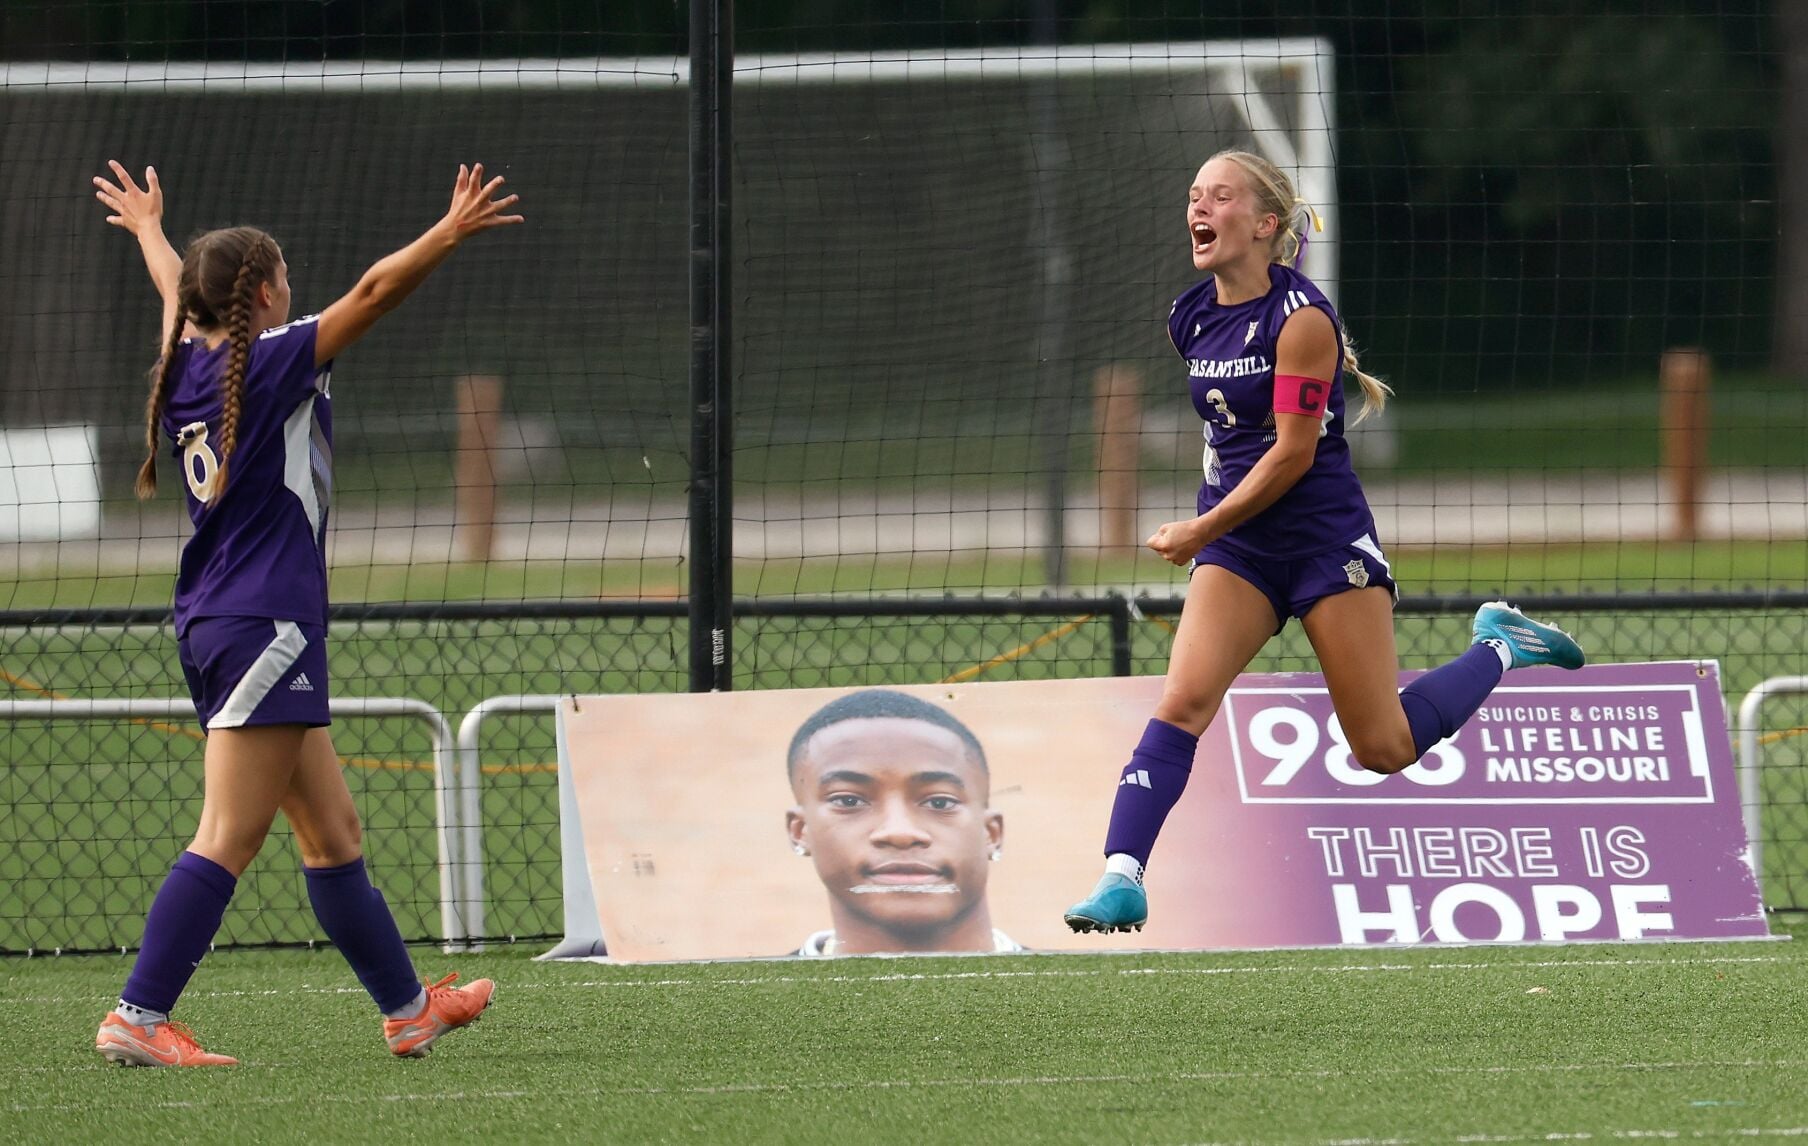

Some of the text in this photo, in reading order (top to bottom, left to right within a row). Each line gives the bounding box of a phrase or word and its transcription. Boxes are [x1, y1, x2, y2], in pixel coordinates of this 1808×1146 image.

[1206, 388, 1237, 428] 3
[1298, 383, 1322, 411] C
[1479, 706, 1660, 722] SUICIDE & CRISIS
[1480, 726, 1665, 752] LIFELINE
[1486, 756, 1670, 782] MISSOURI
[1307, 825, 1650, 879] THERE IS
